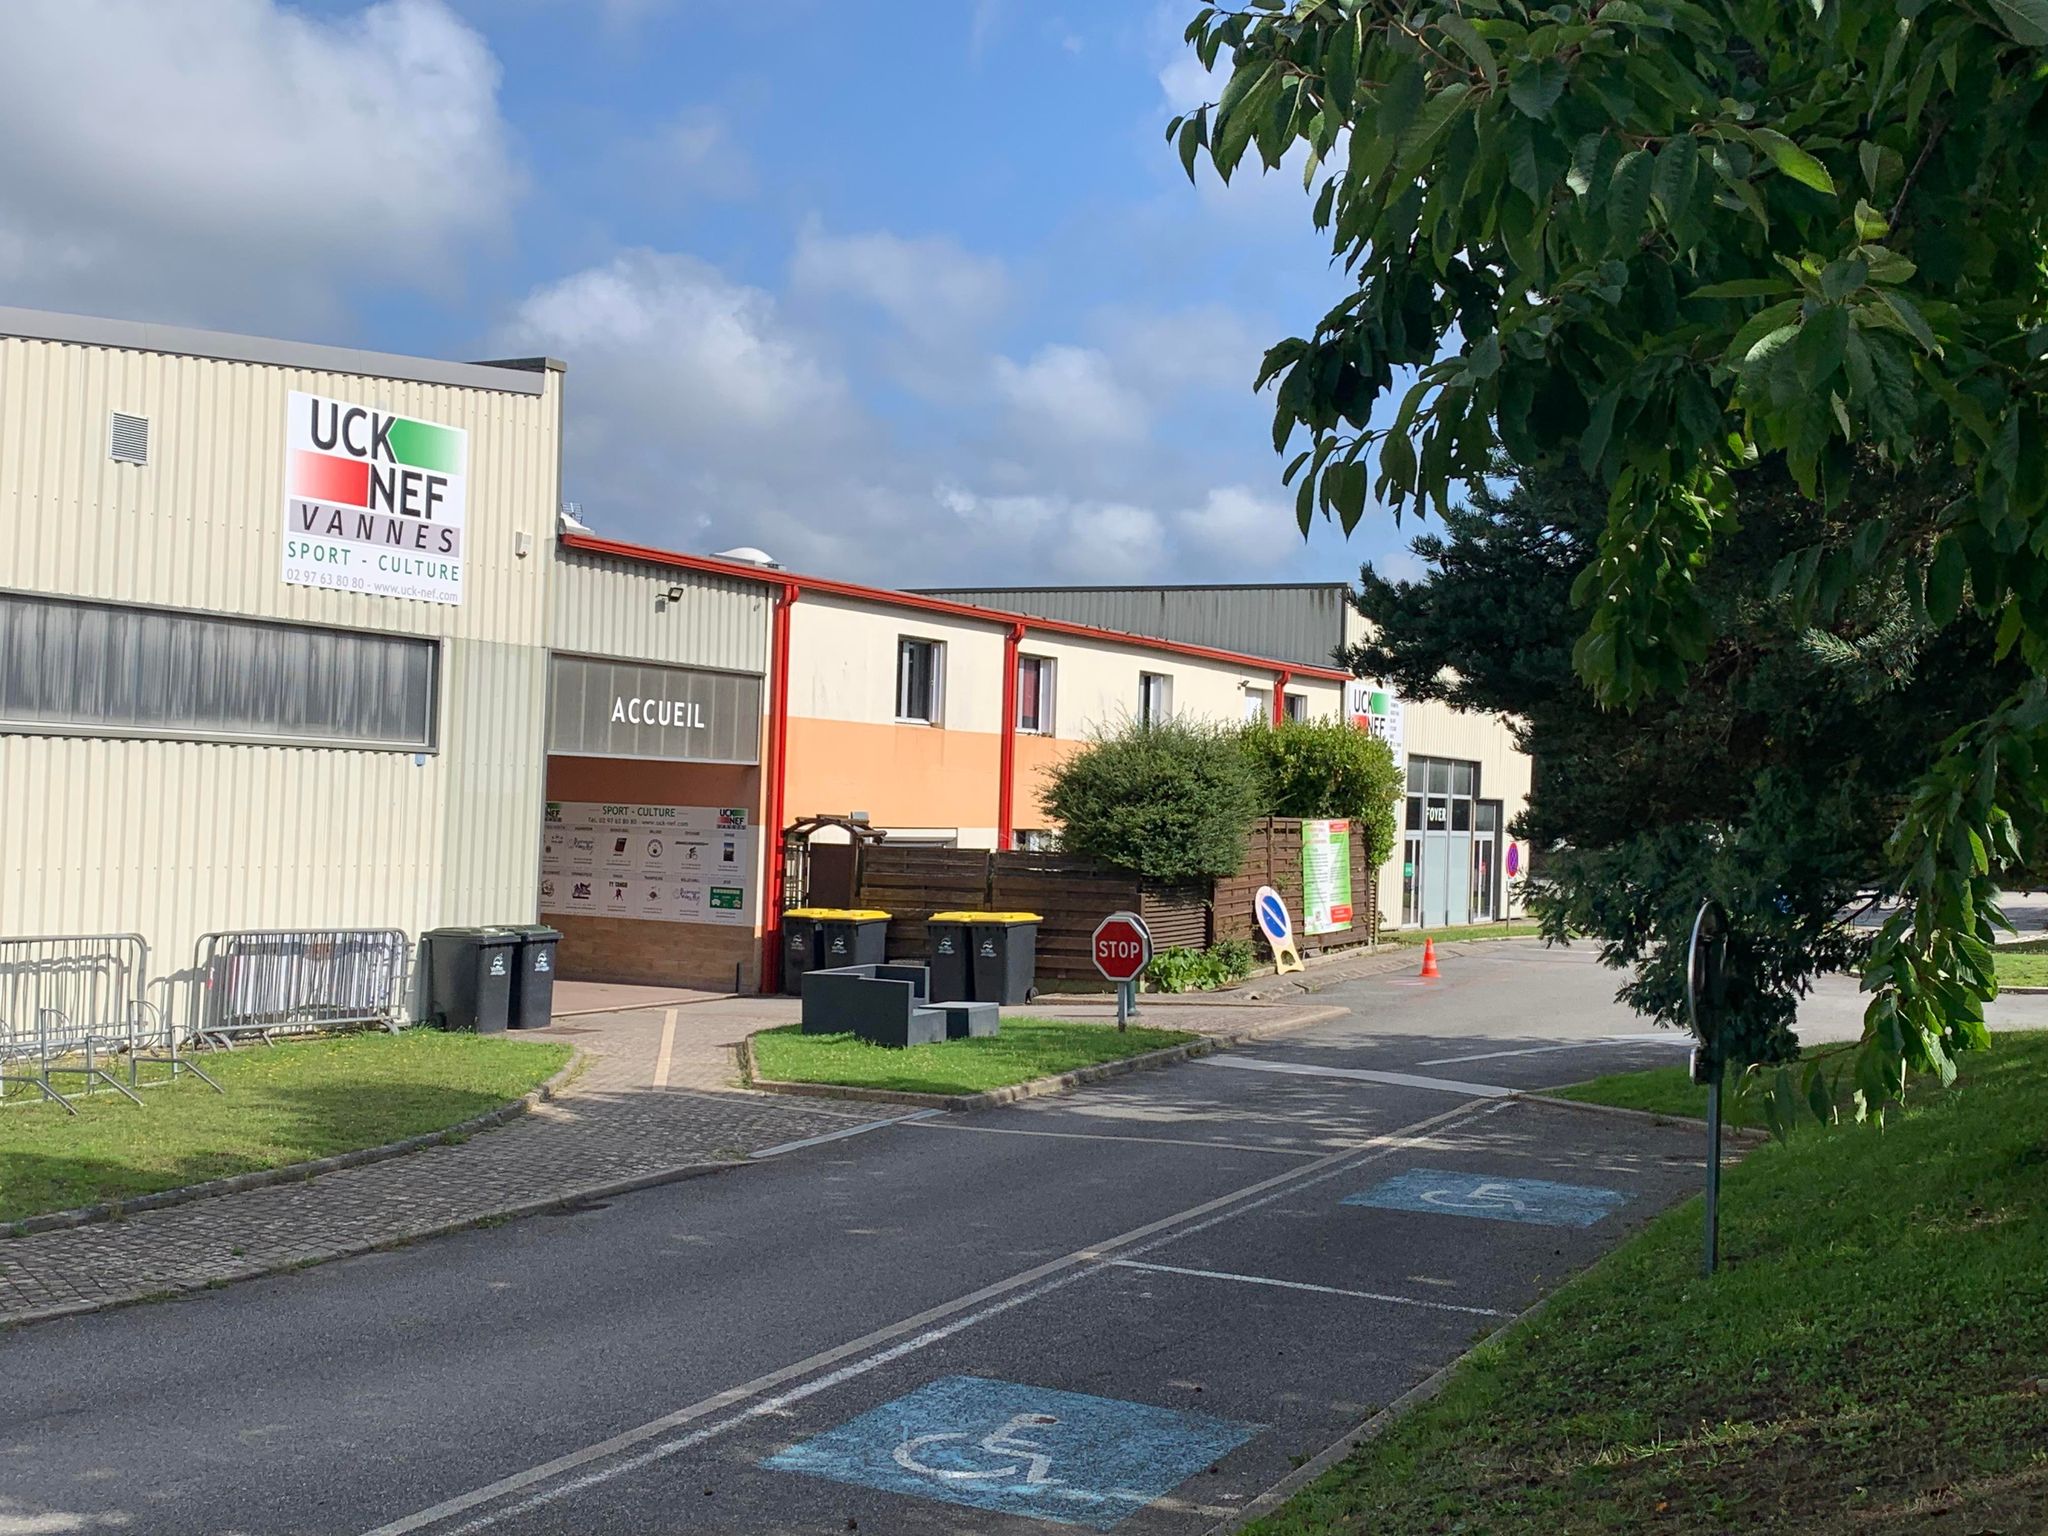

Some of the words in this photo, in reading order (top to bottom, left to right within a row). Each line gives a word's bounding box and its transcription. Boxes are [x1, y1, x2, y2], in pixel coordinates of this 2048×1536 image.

[311, 398, 396, 464] UCK
[369, 464, 448, 520] NEF
[302, 503, 453, 553] VANNES
[288, 541, 351, 565] SPORT
[378, 555, 459, 581] CULTURE
[287, 568, 300, 581] 02
[304, 570, 316, 583] 97
[320, 572, 332, 585] 63
[336, 574, 349, 587] 80
[352, 576, 364, 589] 80
[374, 583, 458, 602] www.uck-nef.com
[611, 697, 705, 728] ACCUEIL
[1354, 689, 1374, 714] UCK
[602, 806, 629, 816] SPORT
[637, 807, 675, 818] CULTURE
[720, 808, 734, 817] UCK
[729, 817, 744, 826] NEF
[1426, 807, 1446, 821] FOYER
[1098, 940, 1139, 959] STOP
